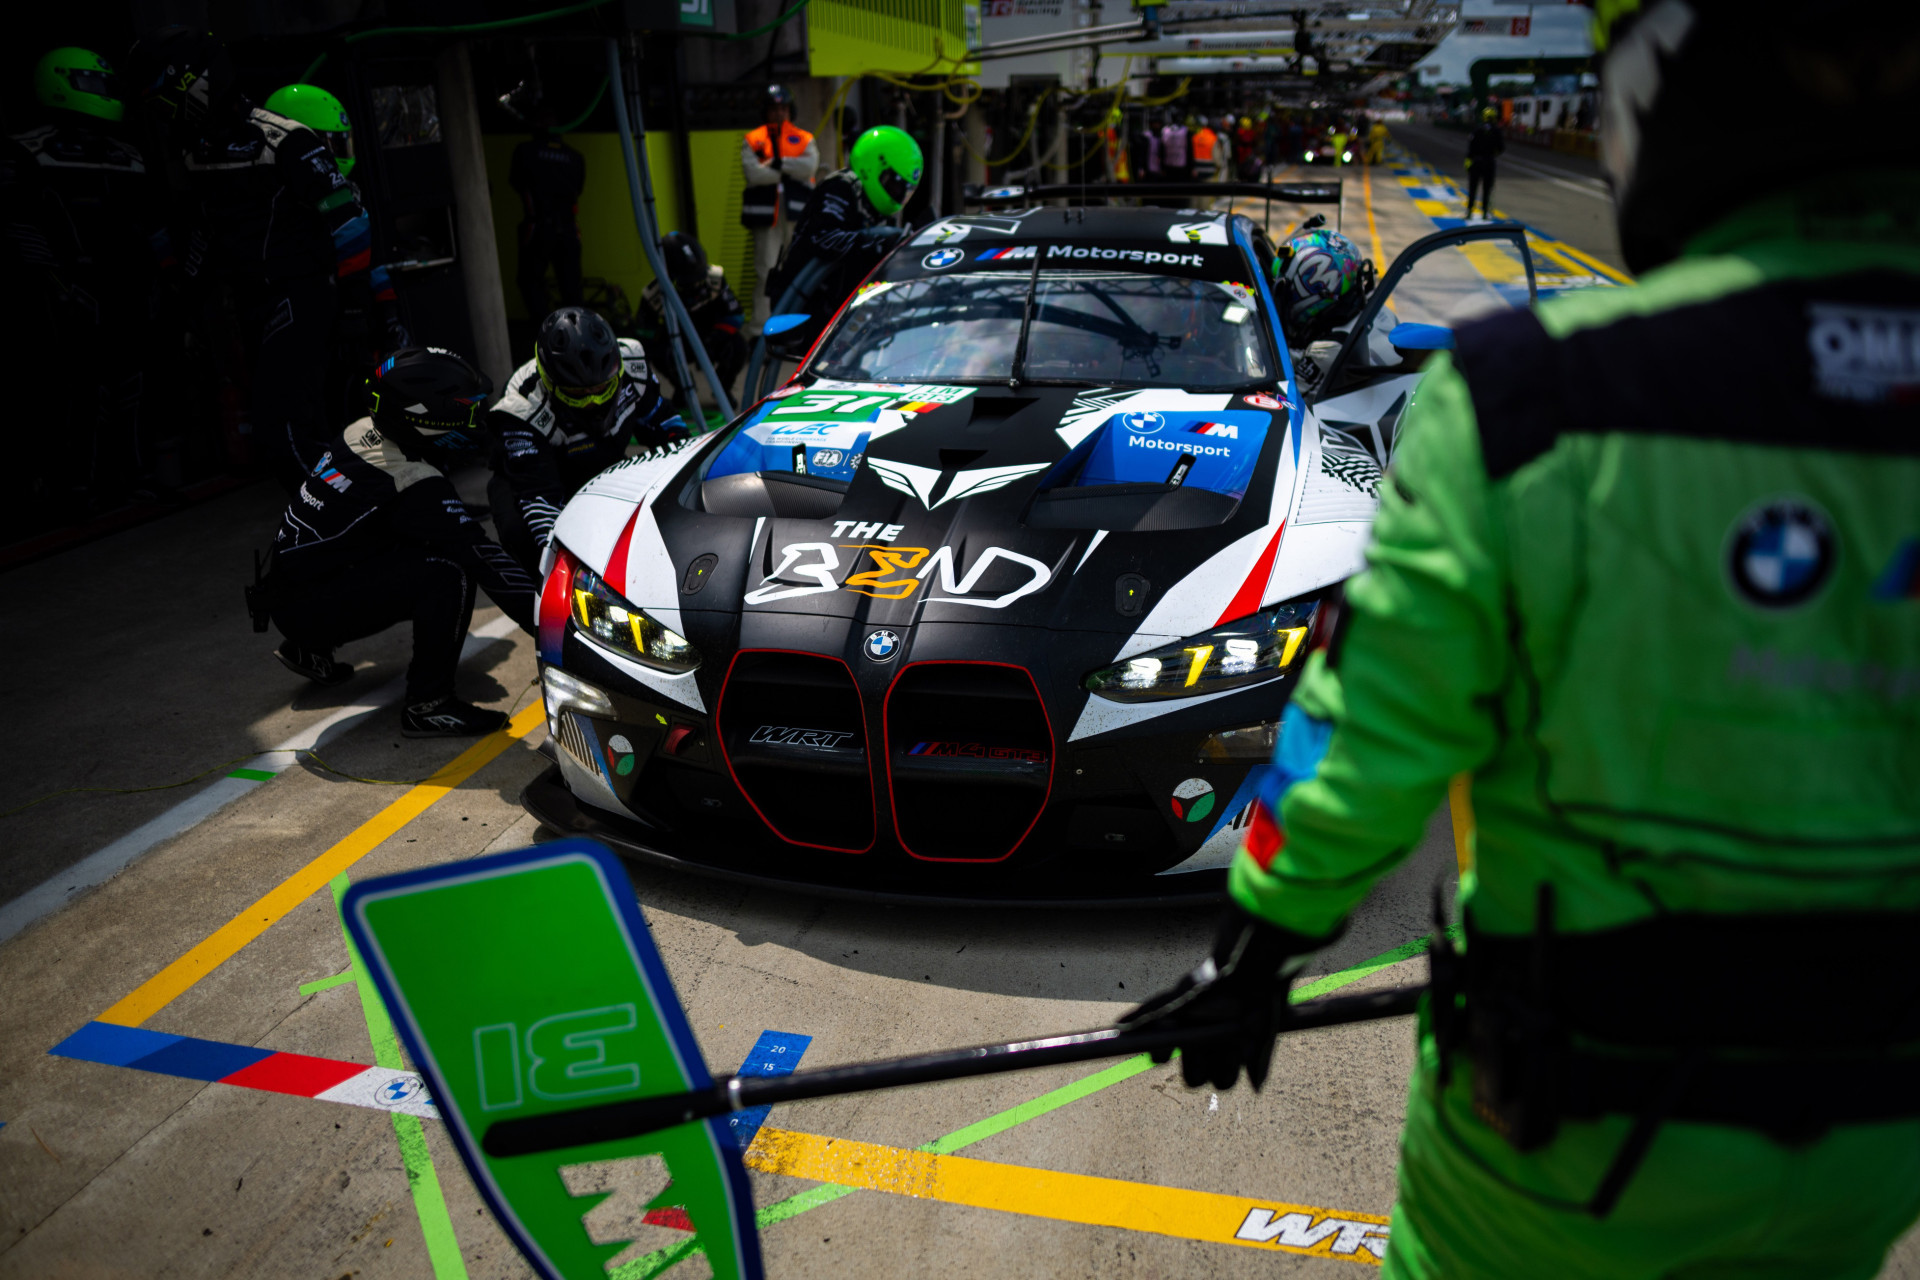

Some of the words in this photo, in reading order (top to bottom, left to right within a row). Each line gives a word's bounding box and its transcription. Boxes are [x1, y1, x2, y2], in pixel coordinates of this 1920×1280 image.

[1046, 245, 1205, 267] Motorsport
[908, 392, 955, 401] GT3
[926, 386, 964, 394] LM
[773, 393, 890, 416] 31
[365, 429, 382, 447] OMP
[771, 423, 840, 436] WEC
[1204, 423, 1239, 439] M
[1128, 435, 1231, 458] Motorsport
[813, 451, 841, 465] FIA
[830, 519, 905, 543] THE
[743, 542, 1052, 609] BEND
[749, 725, 855, 748] WRT
[930, 741, 987, 759] M4
[770, 1045, 787, 1054] 20
[762, 1062, 776, 1071] 15
